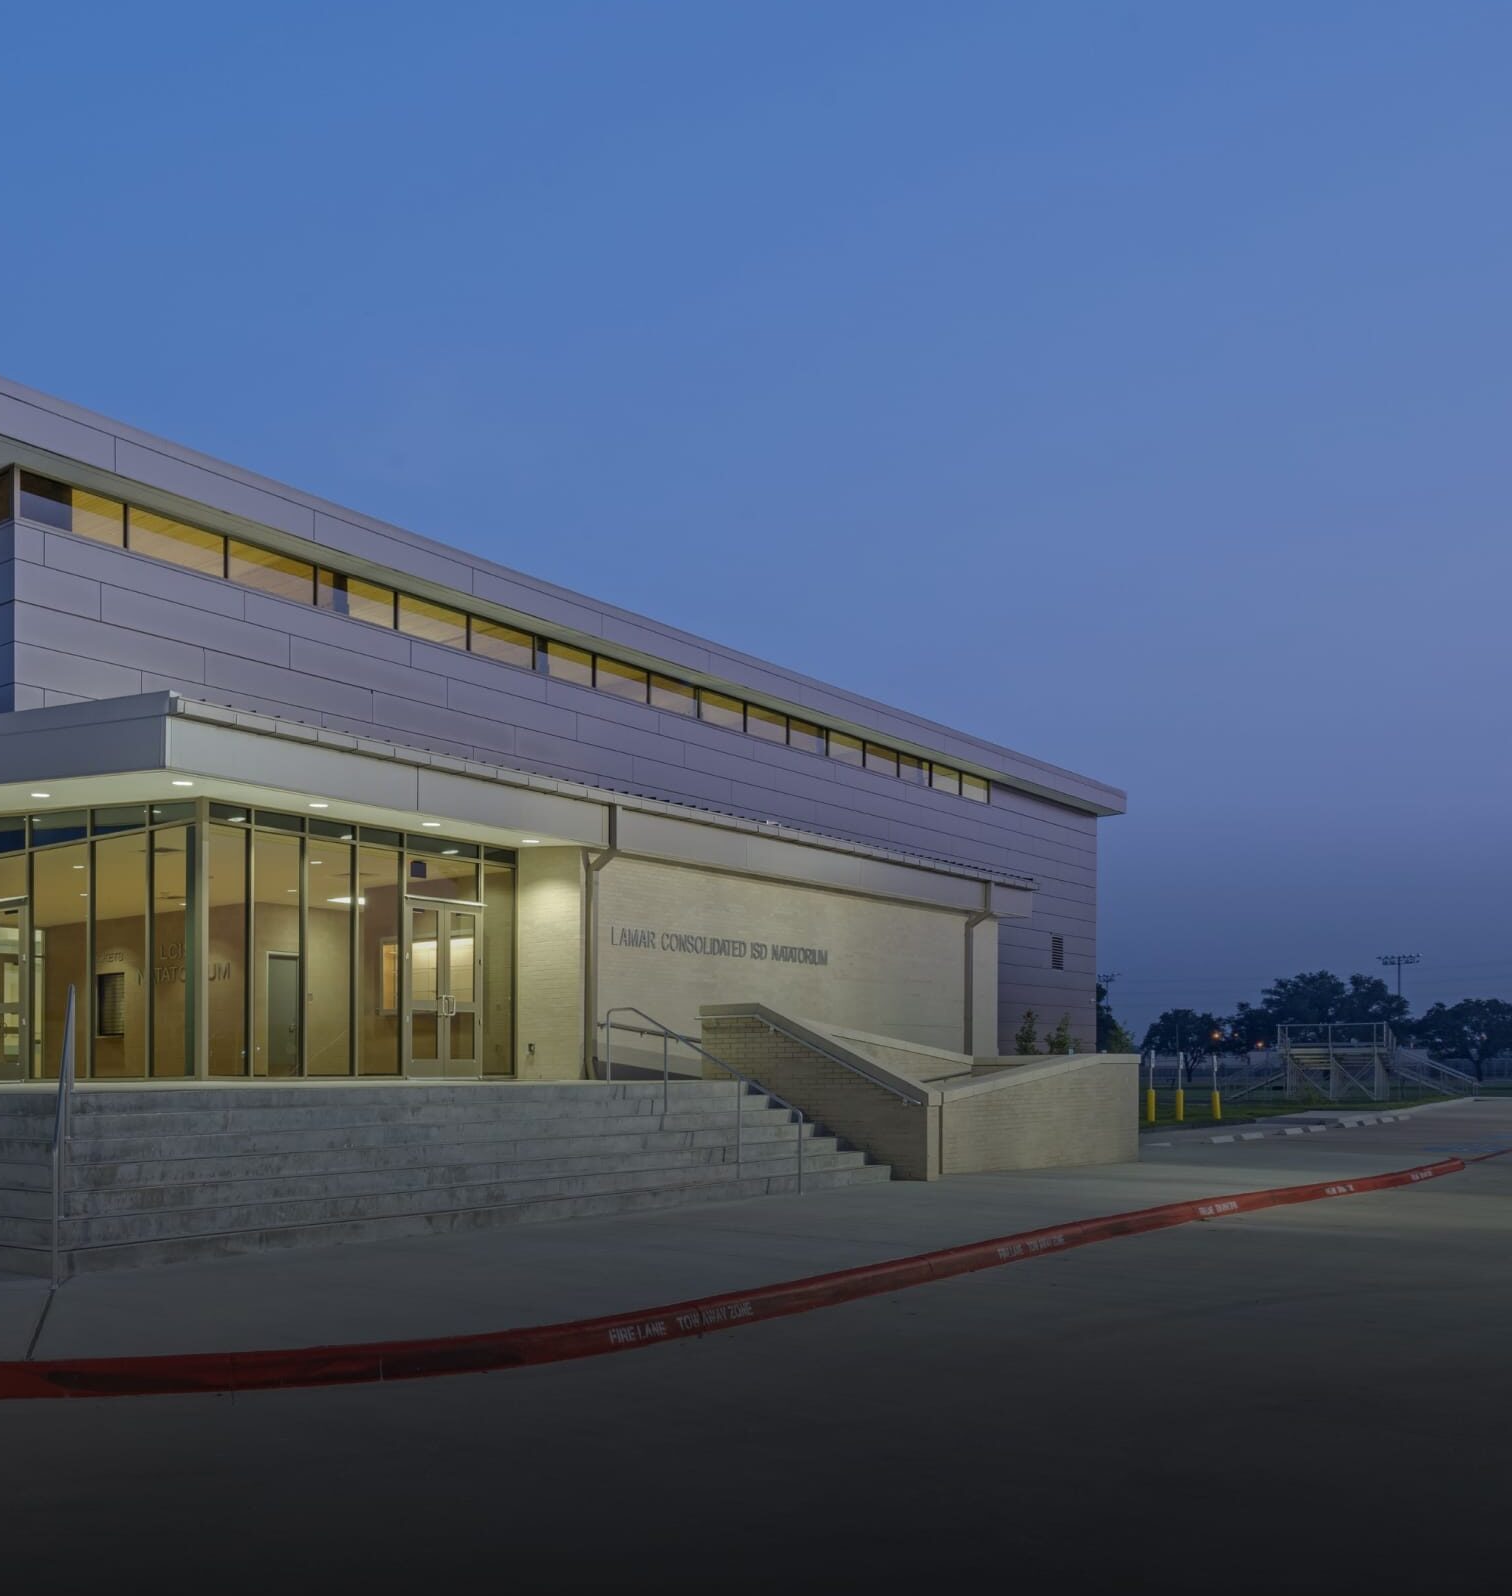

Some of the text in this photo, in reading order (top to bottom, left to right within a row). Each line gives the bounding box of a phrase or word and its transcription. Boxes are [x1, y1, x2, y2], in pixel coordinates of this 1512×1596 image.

[611, 926, 829, 966] LAMAR CONSOLIDATED ISD NATATORIUM
[136, 961, 231, 986] NTATOUM
[608, 1320, 667, 1345] FIRE LANE
[676, 1313, 699, 1331] TOW
